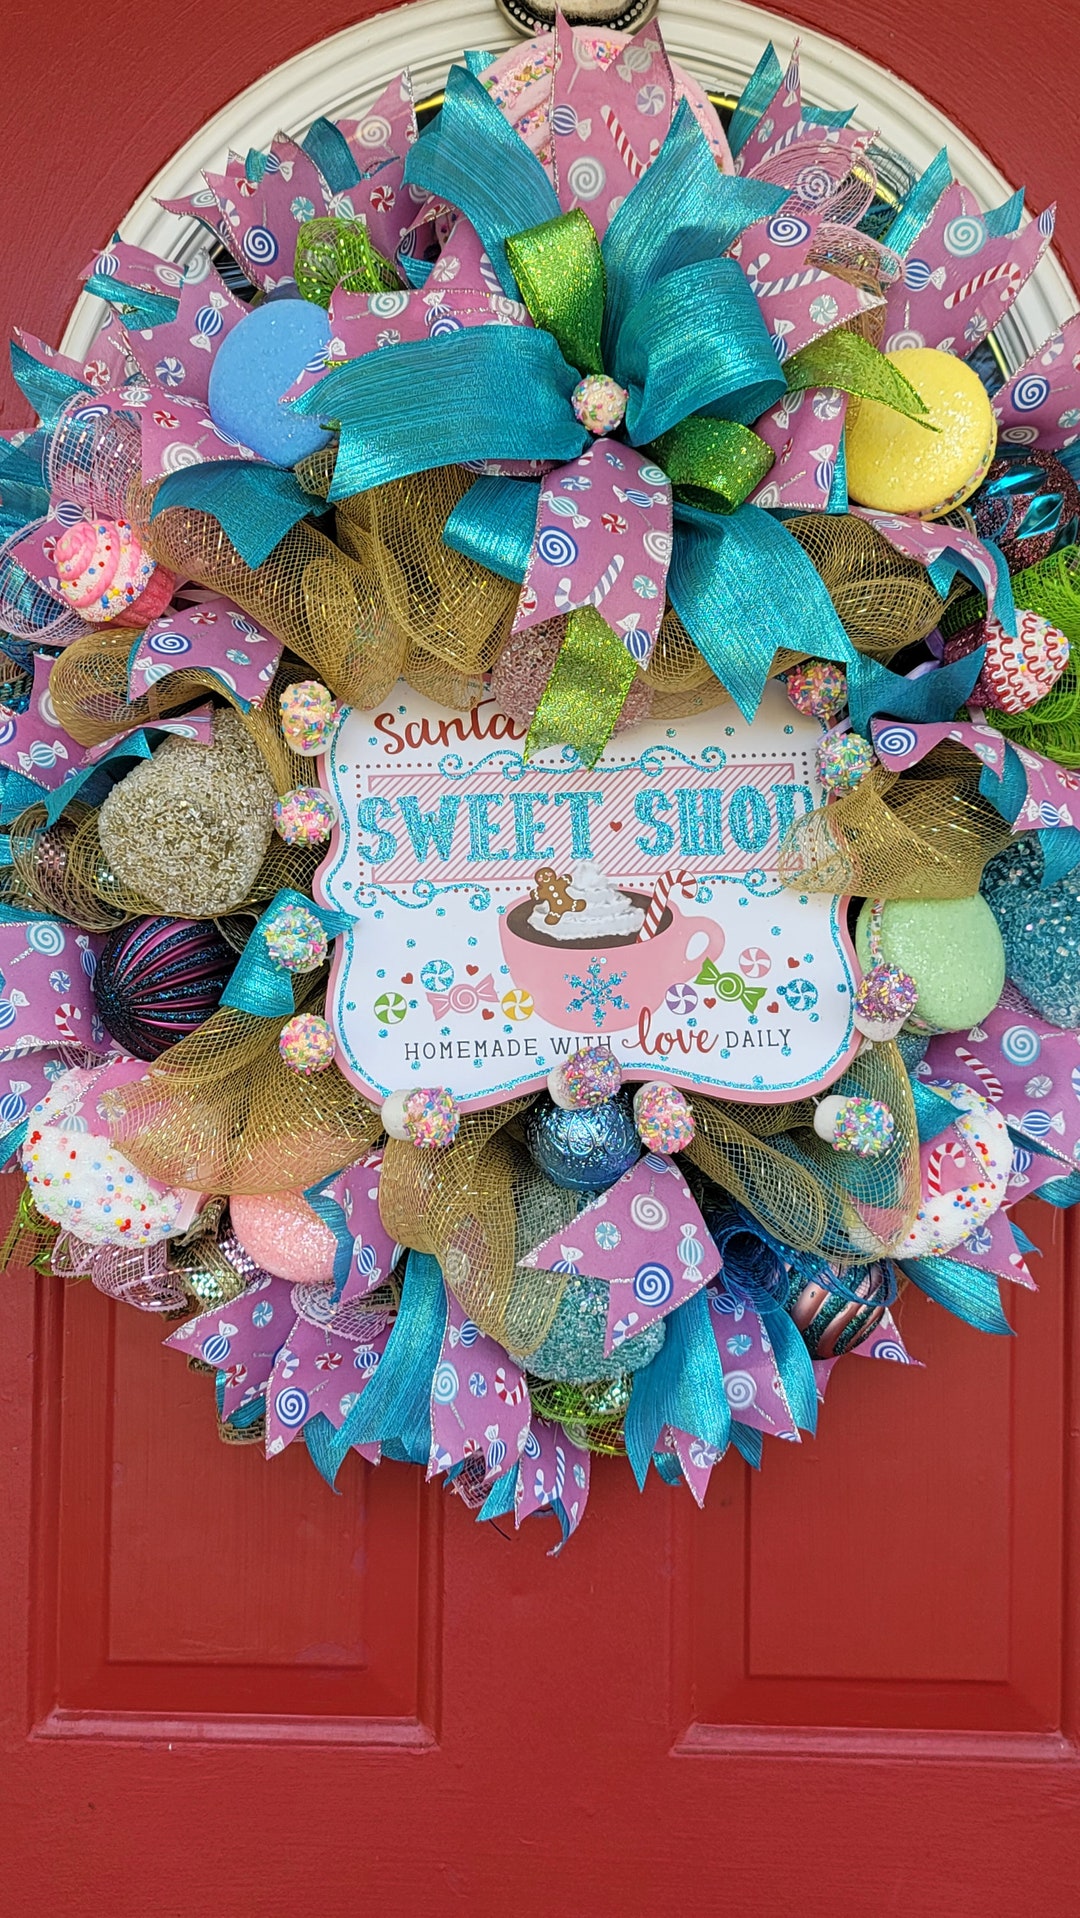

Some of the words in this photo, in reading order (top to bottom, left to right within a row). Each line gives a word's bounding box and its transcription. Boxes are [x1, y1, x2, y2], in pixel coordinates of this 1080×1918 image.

[374, 697, 527, 755] Santa
[357, 790, 604, 865] SWEET
[634, 783, 815, 857] SHOP
[405, 1038, 538, 1061] HOMEMADE
[621, 1006, 719, 1056] love
[726, 1029, 791, 1048] DAILY
